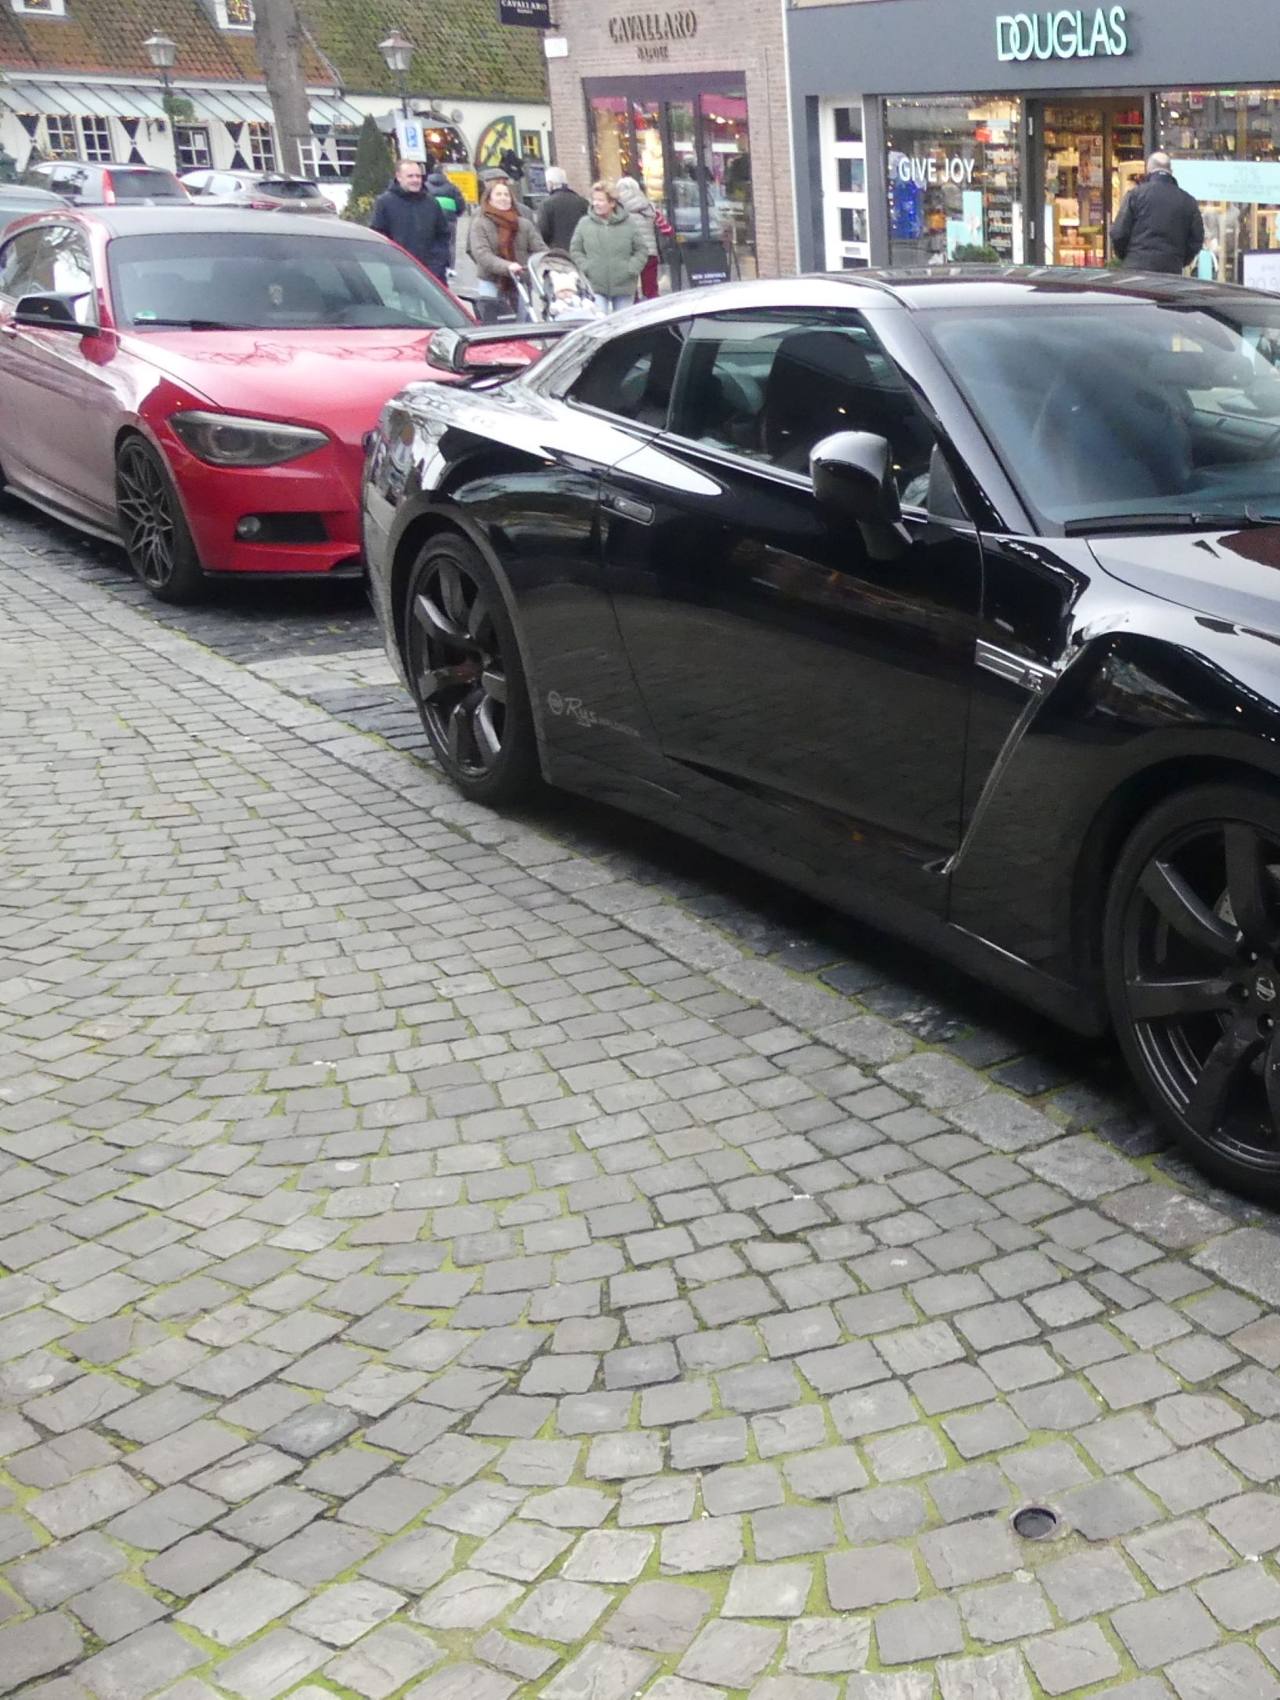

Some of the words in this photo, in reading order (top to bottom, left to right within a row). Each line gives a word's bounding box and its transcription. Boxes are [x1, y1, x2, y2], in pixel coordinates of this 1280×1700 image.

[609, 10, 698, 43] CAVALLARO
[996, 5, 1127, 61] DOUGLAS
[899, 157, 938, 183] GIVE
[942, 157, 975, 183] JOY
